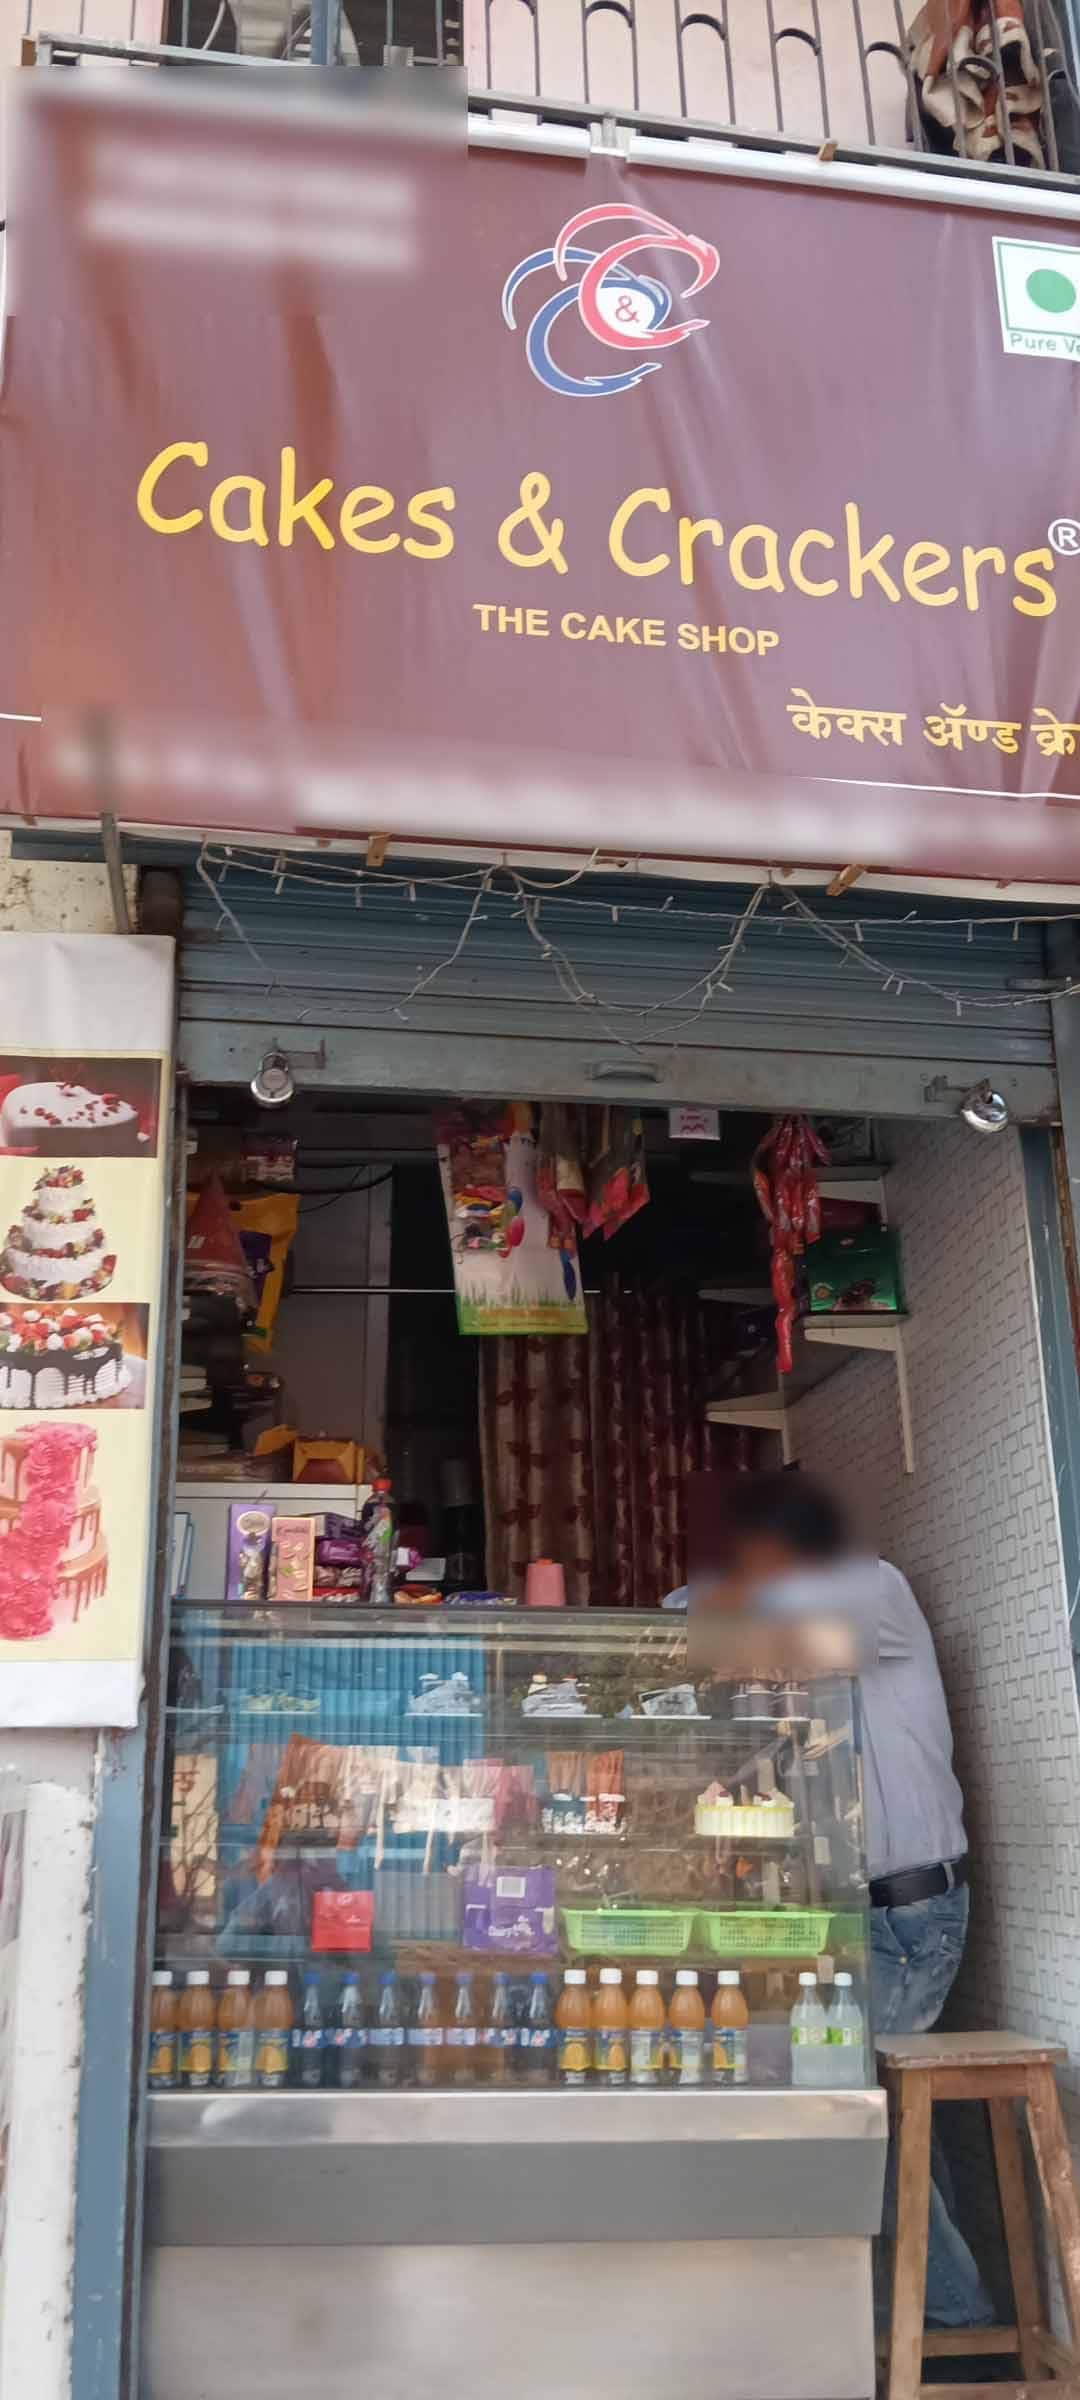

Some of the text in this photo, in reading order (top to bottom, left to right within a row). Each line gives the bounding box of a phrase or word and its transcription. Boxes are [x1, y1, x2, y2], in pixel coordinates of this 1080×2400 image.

[1009, 332, 1057, 352] Pure
[137, 441, 456, 560] Cakes
[498, 471, 569, 575] &
[608, 487, 1058, 617] Crackers
[472, 603, 780, 656] THE CAKE SHOP
[786, 687, 908, 747] केक्स
[1030, 707, 1080, 757] क्रे
